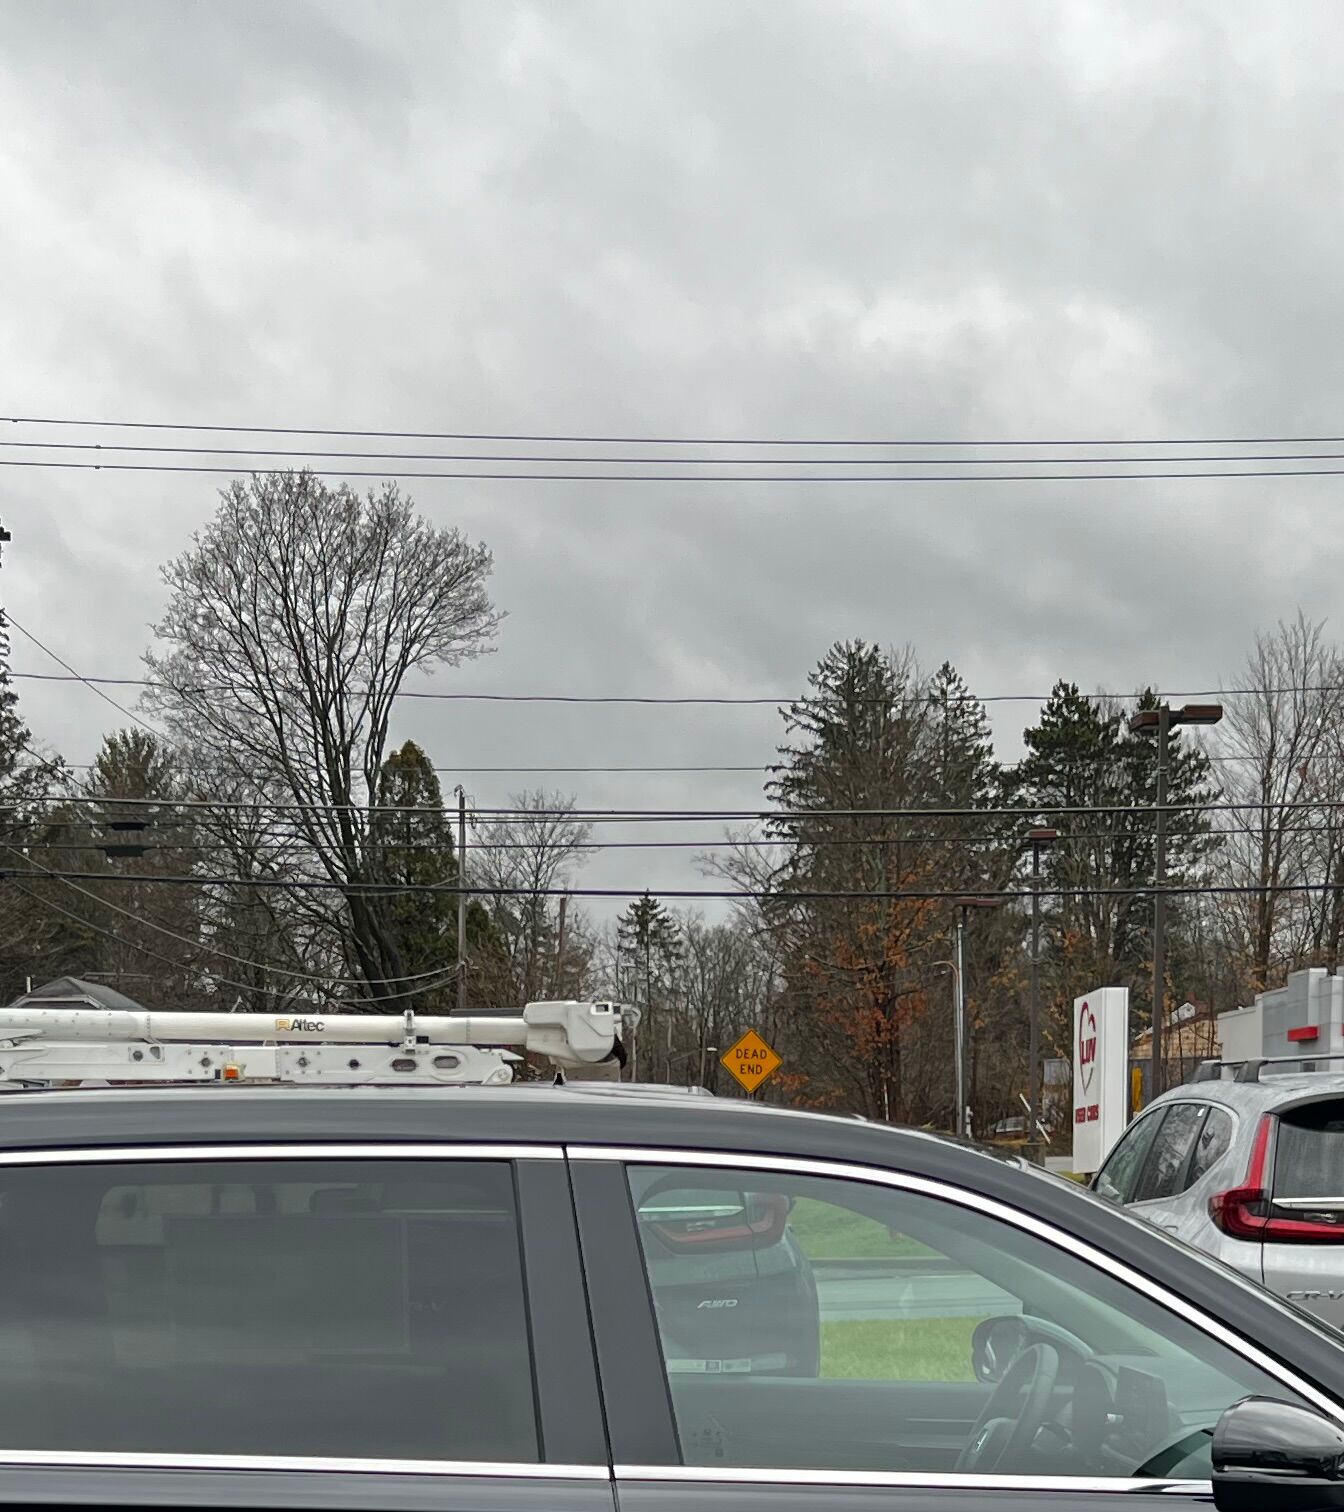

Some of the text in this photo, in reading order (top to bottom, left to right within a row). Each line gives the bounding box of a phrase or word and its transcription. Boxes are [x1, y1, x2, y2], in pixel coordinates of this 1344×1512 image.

[735, 1048, 768, 1060] DEAD
[740, 1063, 763, 1075] END
[696, 1298, 738, 1309] AWD
